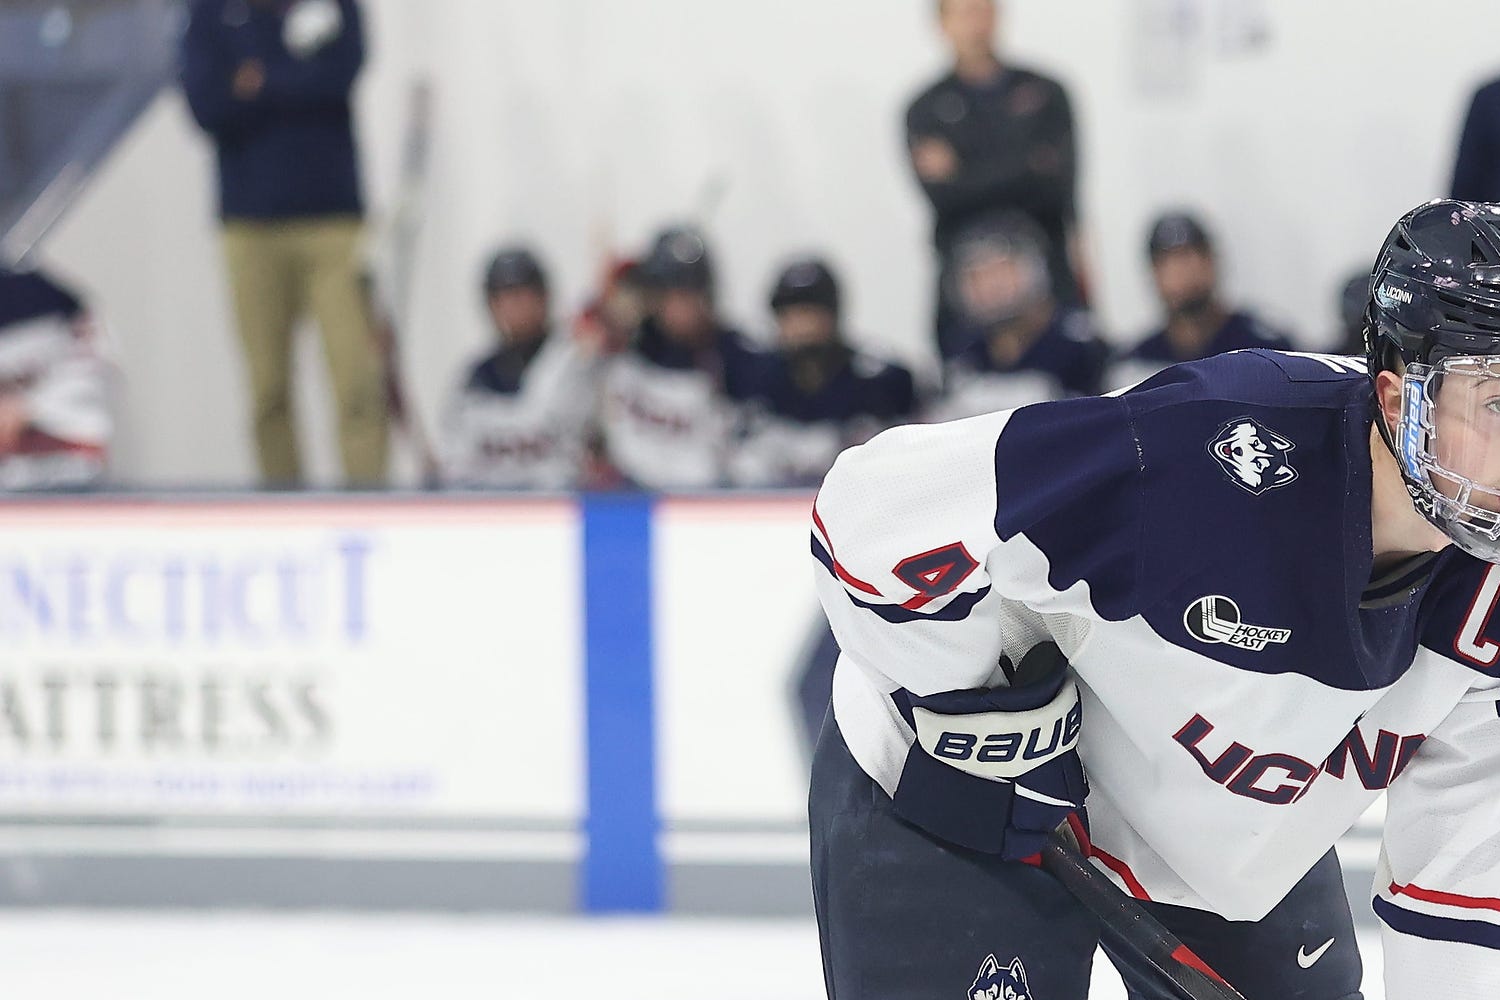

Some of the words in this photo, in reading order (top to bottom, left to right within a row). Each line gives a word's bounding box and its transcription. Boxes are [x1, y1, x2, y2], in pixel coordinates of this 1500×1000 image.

[1386, 285, 1413, 304] UCONN
[1408, 382, 1422, 478] BAUER
[892, 540, 980, 602] 4
[1228, 634, 1266, 649] EAST
[1235, 625, 1290, 641] HOCKEY
[934, 701, 1082, 762] BAUE
